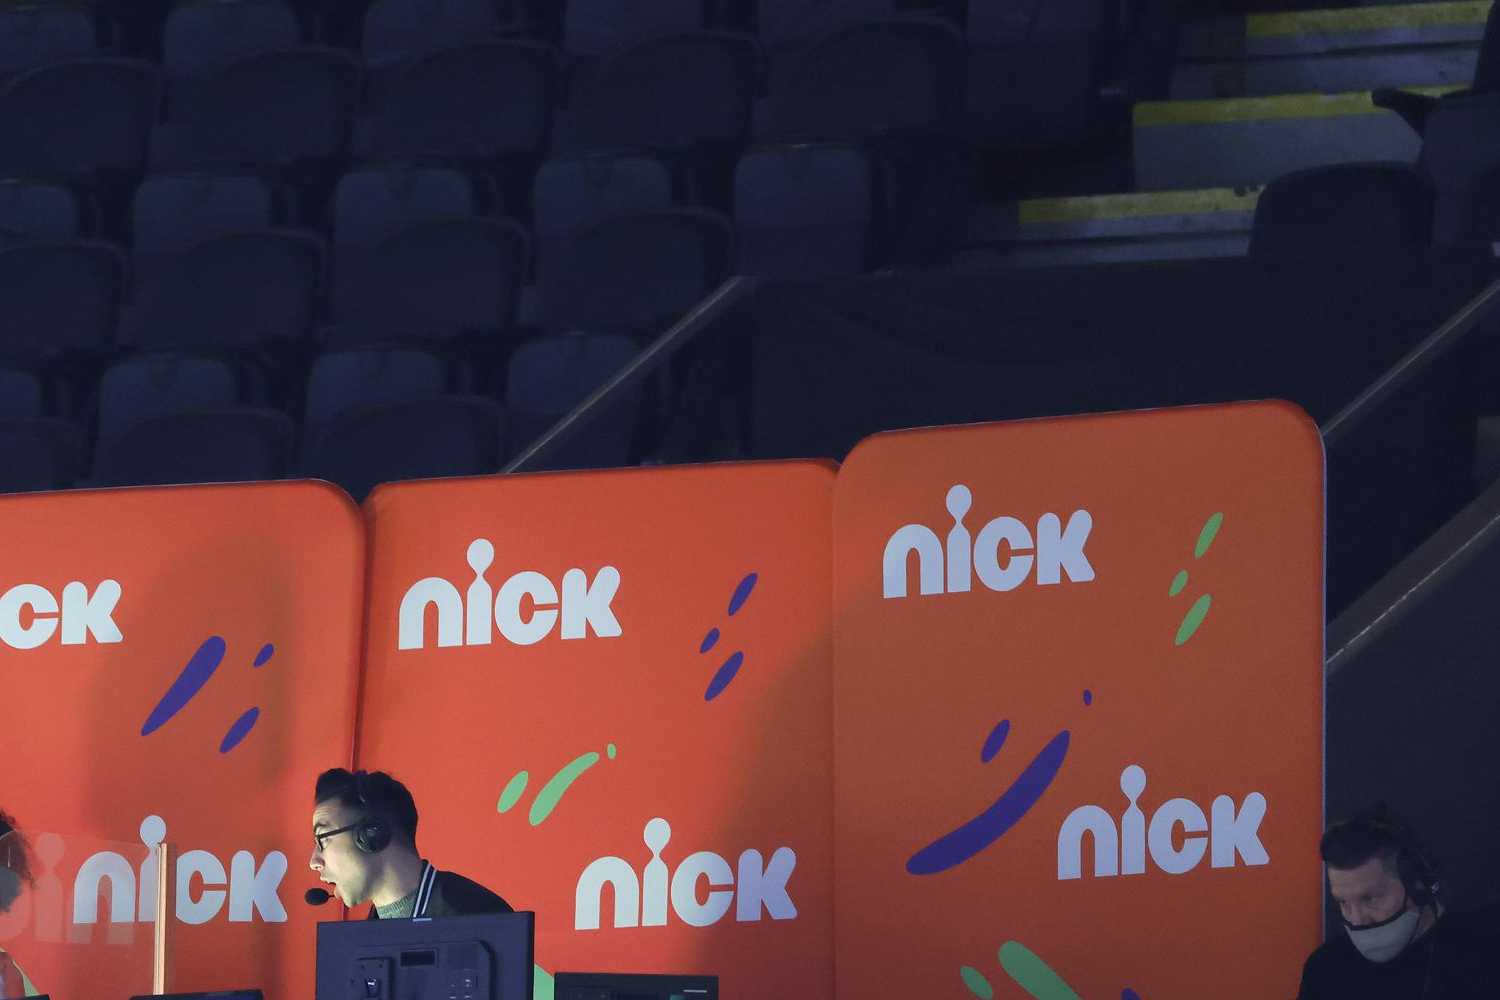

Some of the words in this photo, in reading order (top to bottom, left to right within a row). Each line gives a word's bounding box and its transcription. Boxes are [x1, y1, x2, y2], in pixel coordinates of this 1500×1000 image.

[398, 538, 623, 651] nick
[882, 484, 1096, 599] nick
[574, 817, 798, 931] nick
[1057, 764, 1270, 881] nick
